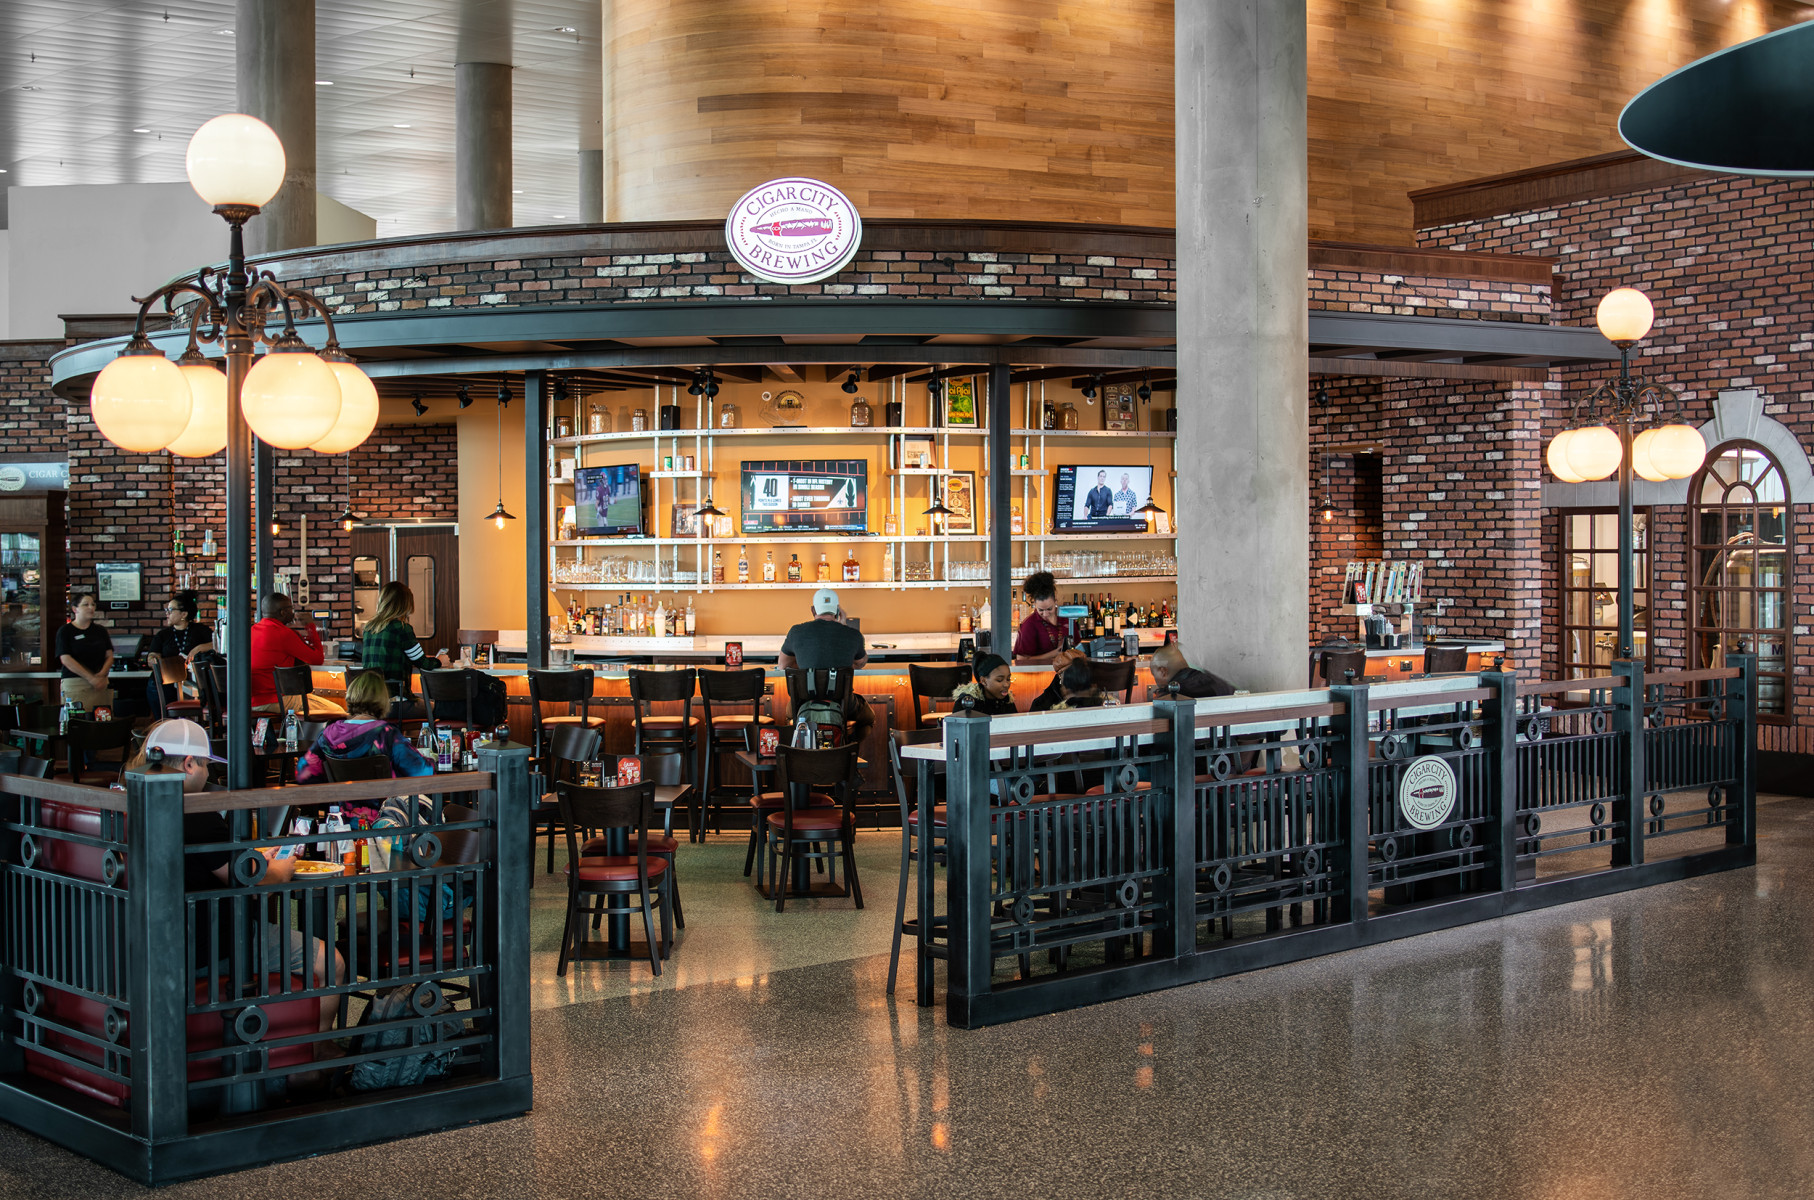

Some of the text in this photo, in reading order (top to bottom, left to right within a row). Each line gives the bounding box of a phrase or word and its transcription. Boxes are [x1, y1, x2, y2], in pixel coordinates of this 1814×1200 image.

[746, 186, 839, 215] CIGAR CITY
[769, 207, 789, 218] HECHO
[795, 206, 813, 214] MANO
[768, 238, 783, 248] BORN
[793, 240, 810, 249] TAMPA
[749, 241, 839, 269] BREWING
[28, 470, 69, 479] CIGAR C
[763, 478, 778, 497] 40
[1771, 644, 1783, 655] M
[1408, 764, 1431, 784] CIGAR
[1431, 763, 1447, 780] CITY
[1409, 801, 1447, 821] BREWING
